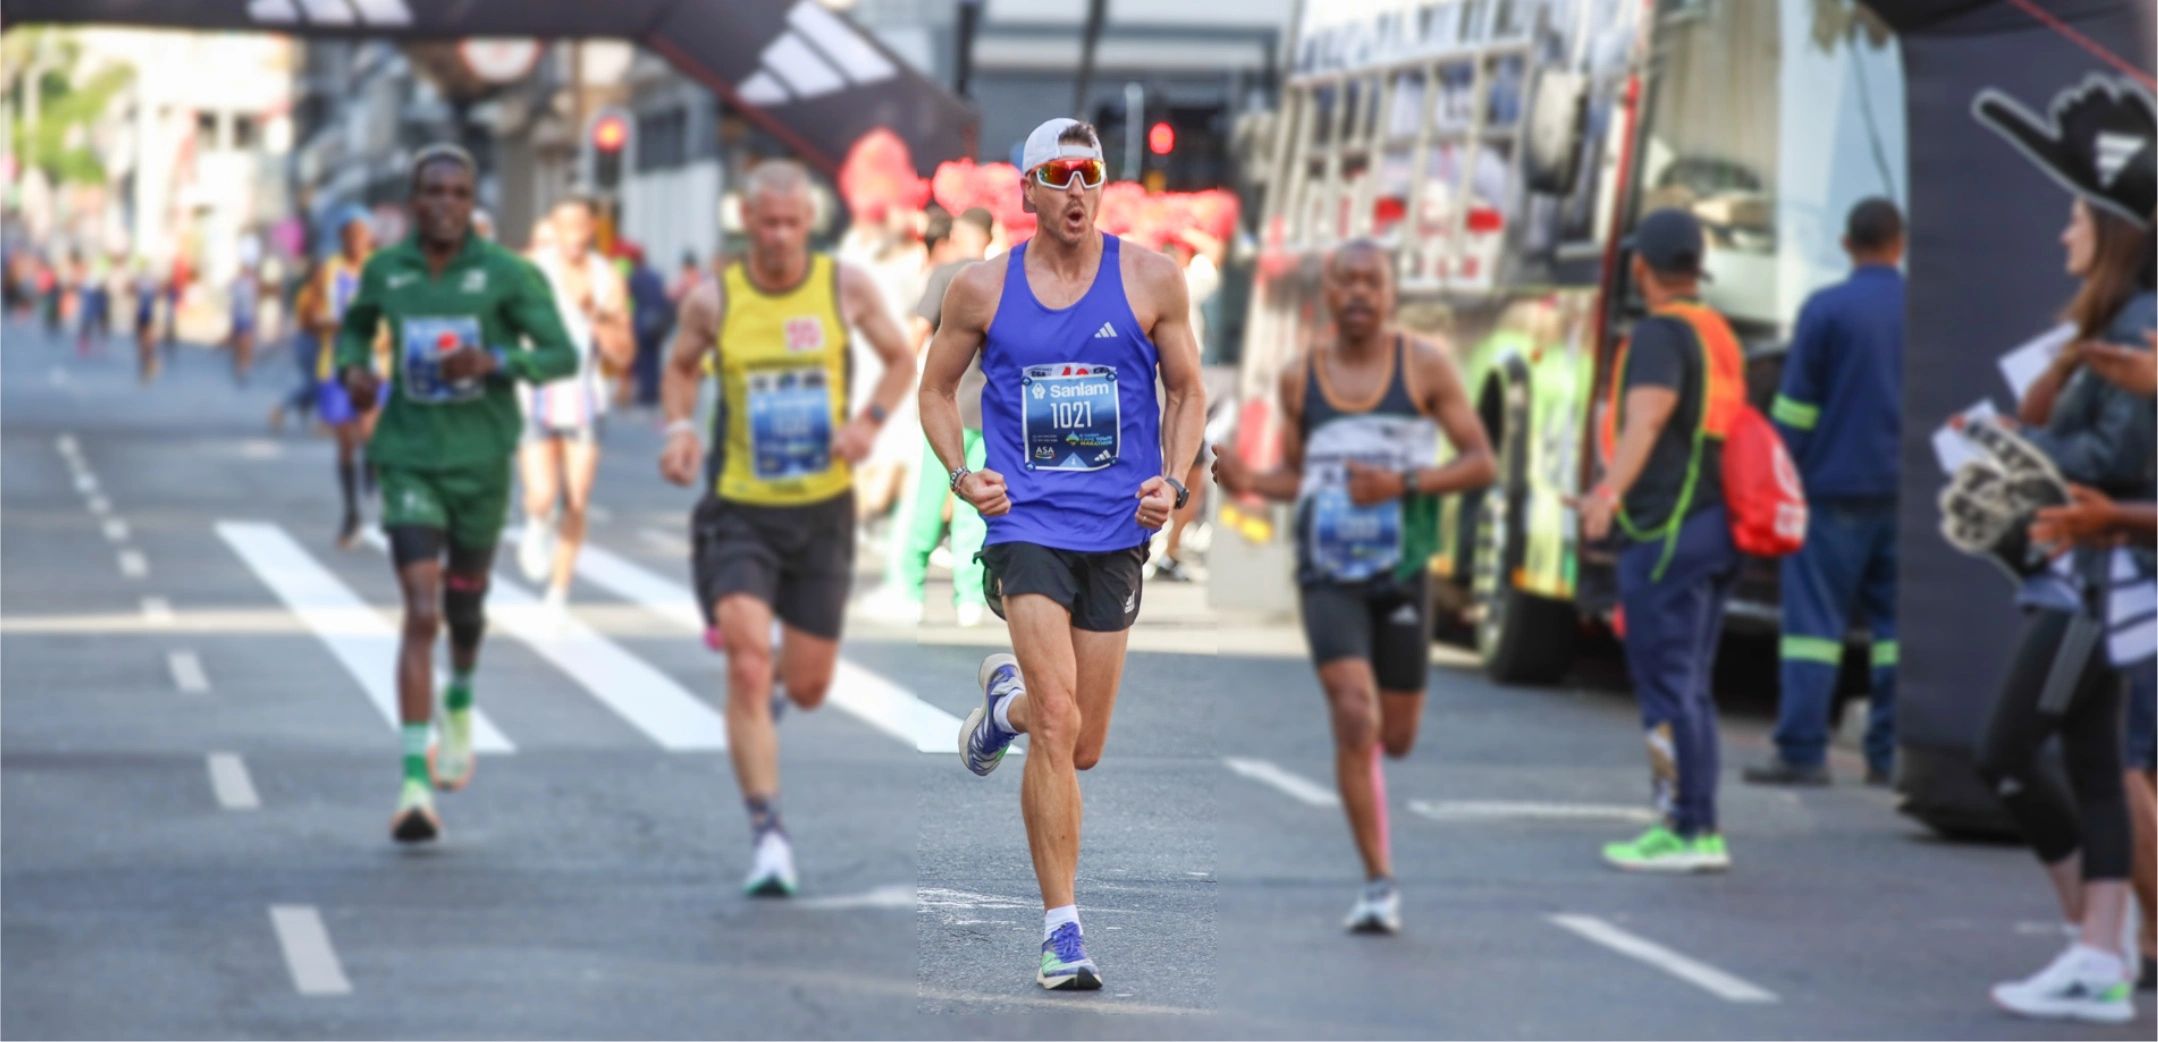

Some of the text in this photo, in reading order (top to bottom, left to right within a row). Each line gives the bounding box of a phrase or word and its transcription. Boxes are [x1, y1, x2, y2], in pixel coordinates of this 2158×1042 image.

[1050, 382, 1109, 398] Sanlam
[1050, 400, 1092, 429] 1021
[1036, 446, 1055, 455] ASA
